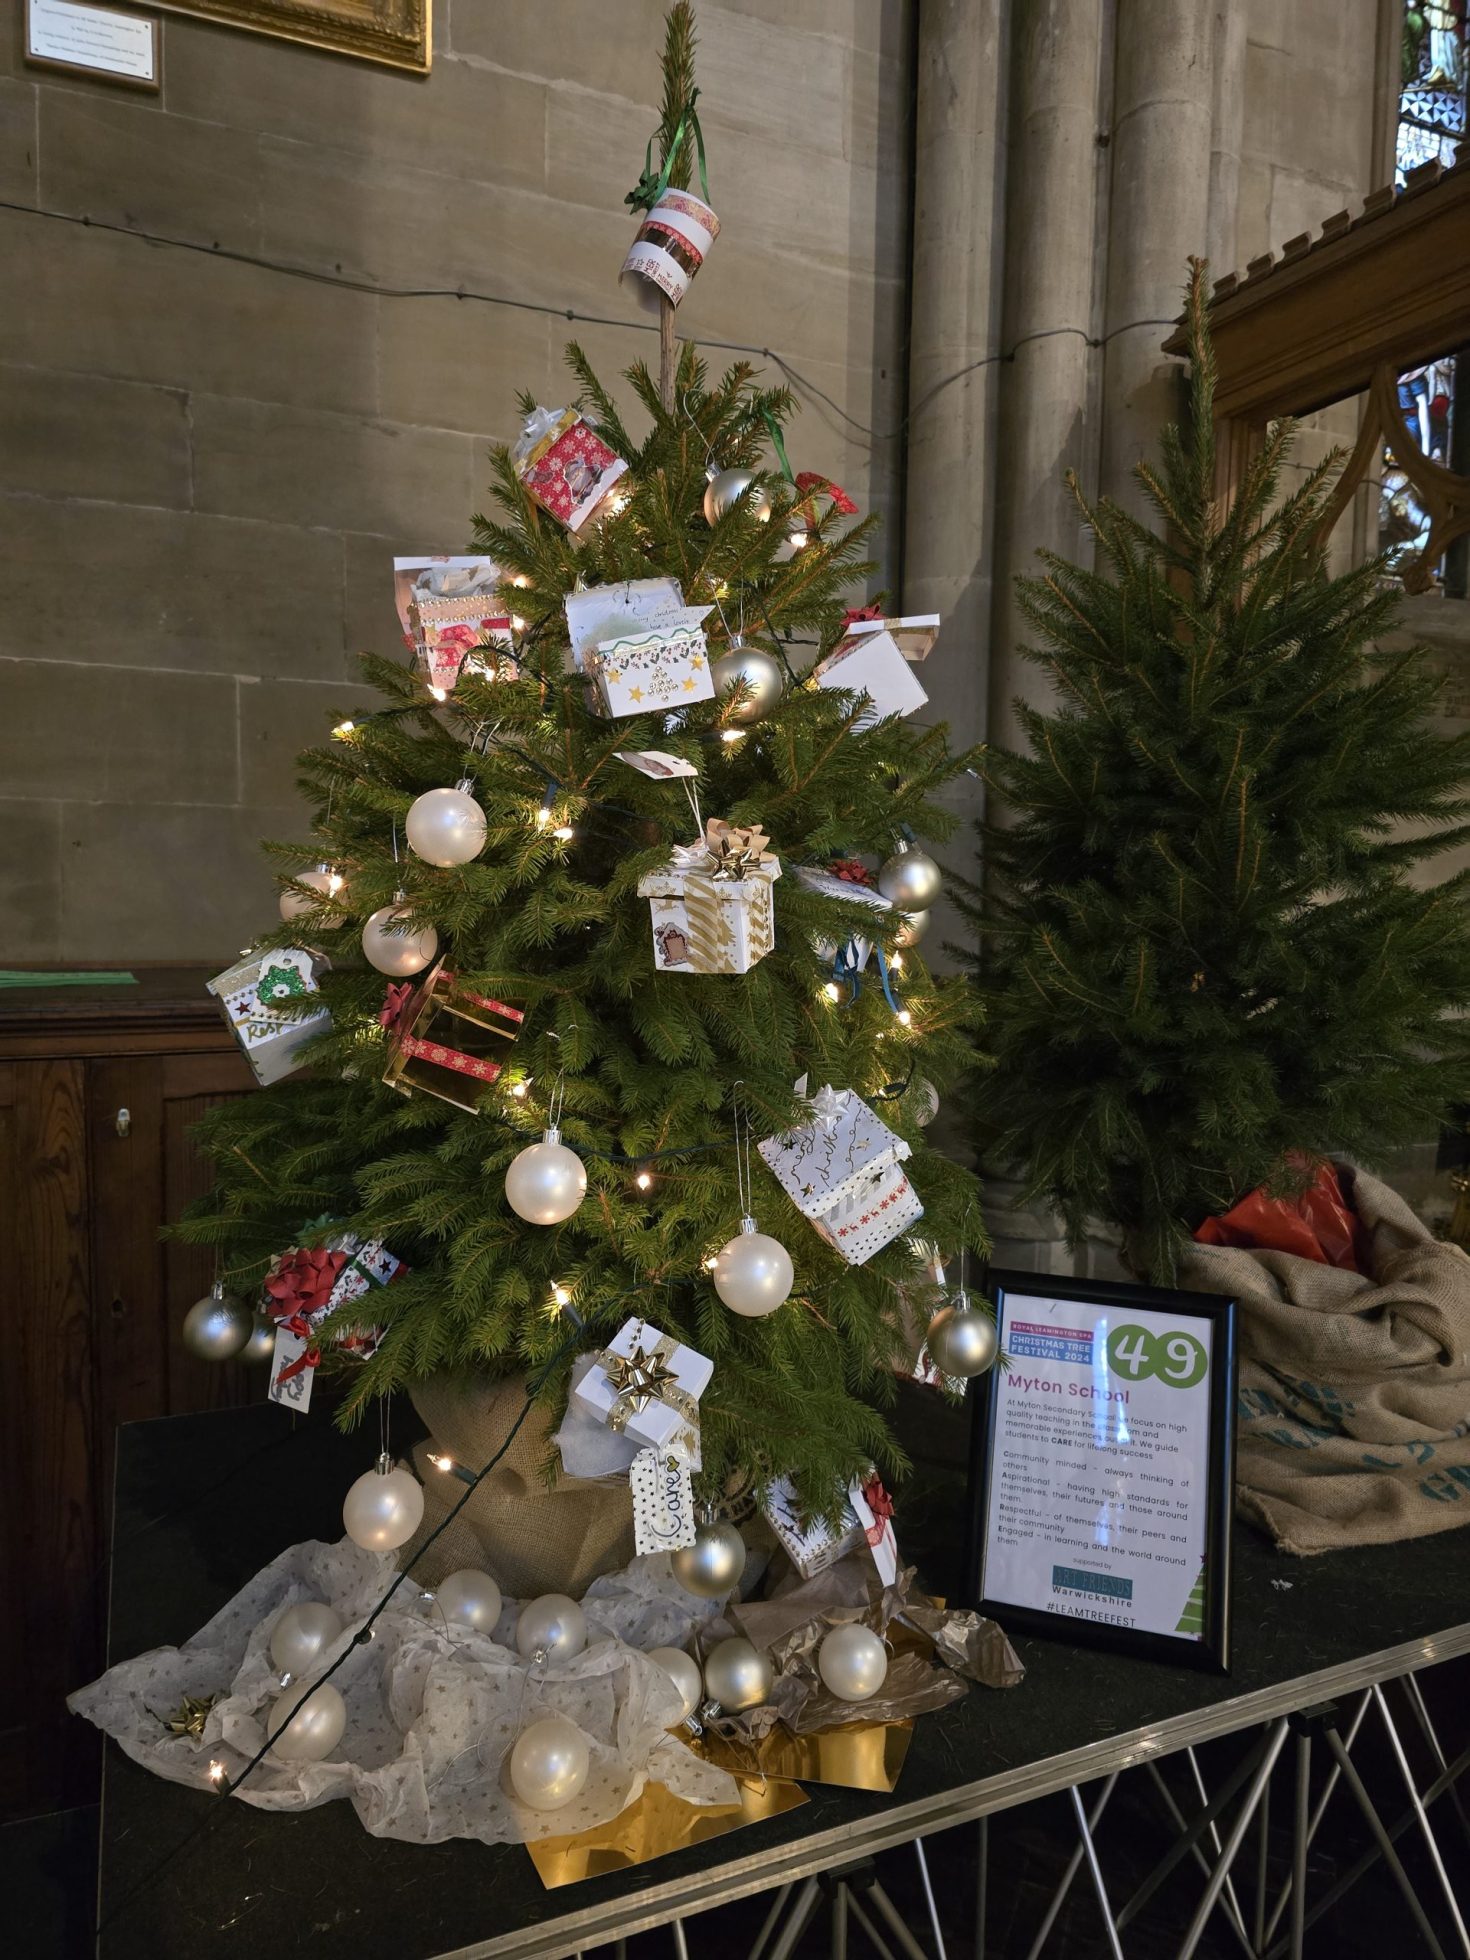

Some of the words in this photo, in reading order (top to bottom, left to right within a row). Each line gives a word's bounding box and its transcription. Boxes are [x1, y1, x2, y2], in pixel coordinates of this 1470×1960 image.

[1012, 1323, 1033, 1332] ROYAL
[1035, 1326, 1077, 1337] LEAMINGTON
[1012, 1335, 1064, 1350] CHRISTMAS
[1068, 1343, 1090, 1353] TREE
[1011, 1345, 1060, 1358] FESTIVAL
[1065, 1352, 1090, 1362] 2024
[1008, 1374, 1062, 1393] Myton
[1068, 1383, 1129, 1404] School
[1006, 1410, 1033, 1420] quality
[1035, 1414, 1070, 1426] teaching
[1082, 1420, 1095, 1428] the
[1142, 1431, 1159, 1439] and
[1017, 1400, 1041, 1410] Myton
[1043, 1404, 1086, 1417] Secondary
[1088, 1410, 1116, 1420] Scol
[1131, 1417, 1153, 1427] focus
[1169, 1423, 1187, 1433] high
[1005, 1420, 1051, 1433] memorable
[1053, 1428, 1102, 1441] experiences
[1140, 1440, 1152, 1448] We
[1155, 1444, 1178, 1453] guide
[1005, 1429, 1041, 1441] students
[1051, 1437, 1072, 1446] CARE
[1074, 1440, 1085, 1448] for
[1120, 1448, 1153, 1460] success
[1002, 1462, 1028, 1471] others
[1003, 1450, 1050, 1465] Community
[1055, 1460, 1087, 1470] minded
[1104, 1468, 1133, 1479] always
[1140, 1473, 1174, 1487] thinking
[651, 1468, 681, 1537] Care
[1001, 1482, 1048, 1497] themselves,
[1052, 1491, 1071, 1500] their
[1075, 1494, 1105, 1507] futures
[1109, 1500, 1125, 1510] and
[1129, 1504, 1153, 1515] those
[1157, 1509, 1188, 1521] around
[1002, 1471, 1050, 1486] Aspirational
[1067, 1482, 1095, 1495] having
[1101, 1488, 1120, 1499] high
[1127, 1493, 1170, 1507] standards
[1176, 1500, 1188, 1510] for
[999, 1514, 1017, 1524] their
[1018, 1519, 1065, 1534] community
[1000, 1503, 1042, 1516] Respectful
[1053, 1513, 1062, 1521] of
[1066, 1515, 1115, 1531] themselves,
[1119, 1525, 1138, 1534] their
[1142, 1529, 1166, 1540] peers
[1170, 1534, 1187, 1543] and
[997, 1536, 1018, 1546] them
[998, 1525, 1034, 1538] Engaged
[1044, 1533, 1052, 1541] in
[1055, 1535, 1089, 1550] learning
[1092, 1543, 1108, 1552] and
[1111, 1546, 1125, 1555] the
[1129, 1550, 1152, 1560] world
[1155, 1554, 1186, 1566] around
[1073, 1558, 1103, 1569] supported
[1104, 1562, 1112, 1570] by
[1052, 1585, 1132, 1608] Warwickshire
[1082, 1573, 1131, 1597] FRIENDS
[1047, 1602, 1136, 1627] #LEAMTREEFEST
